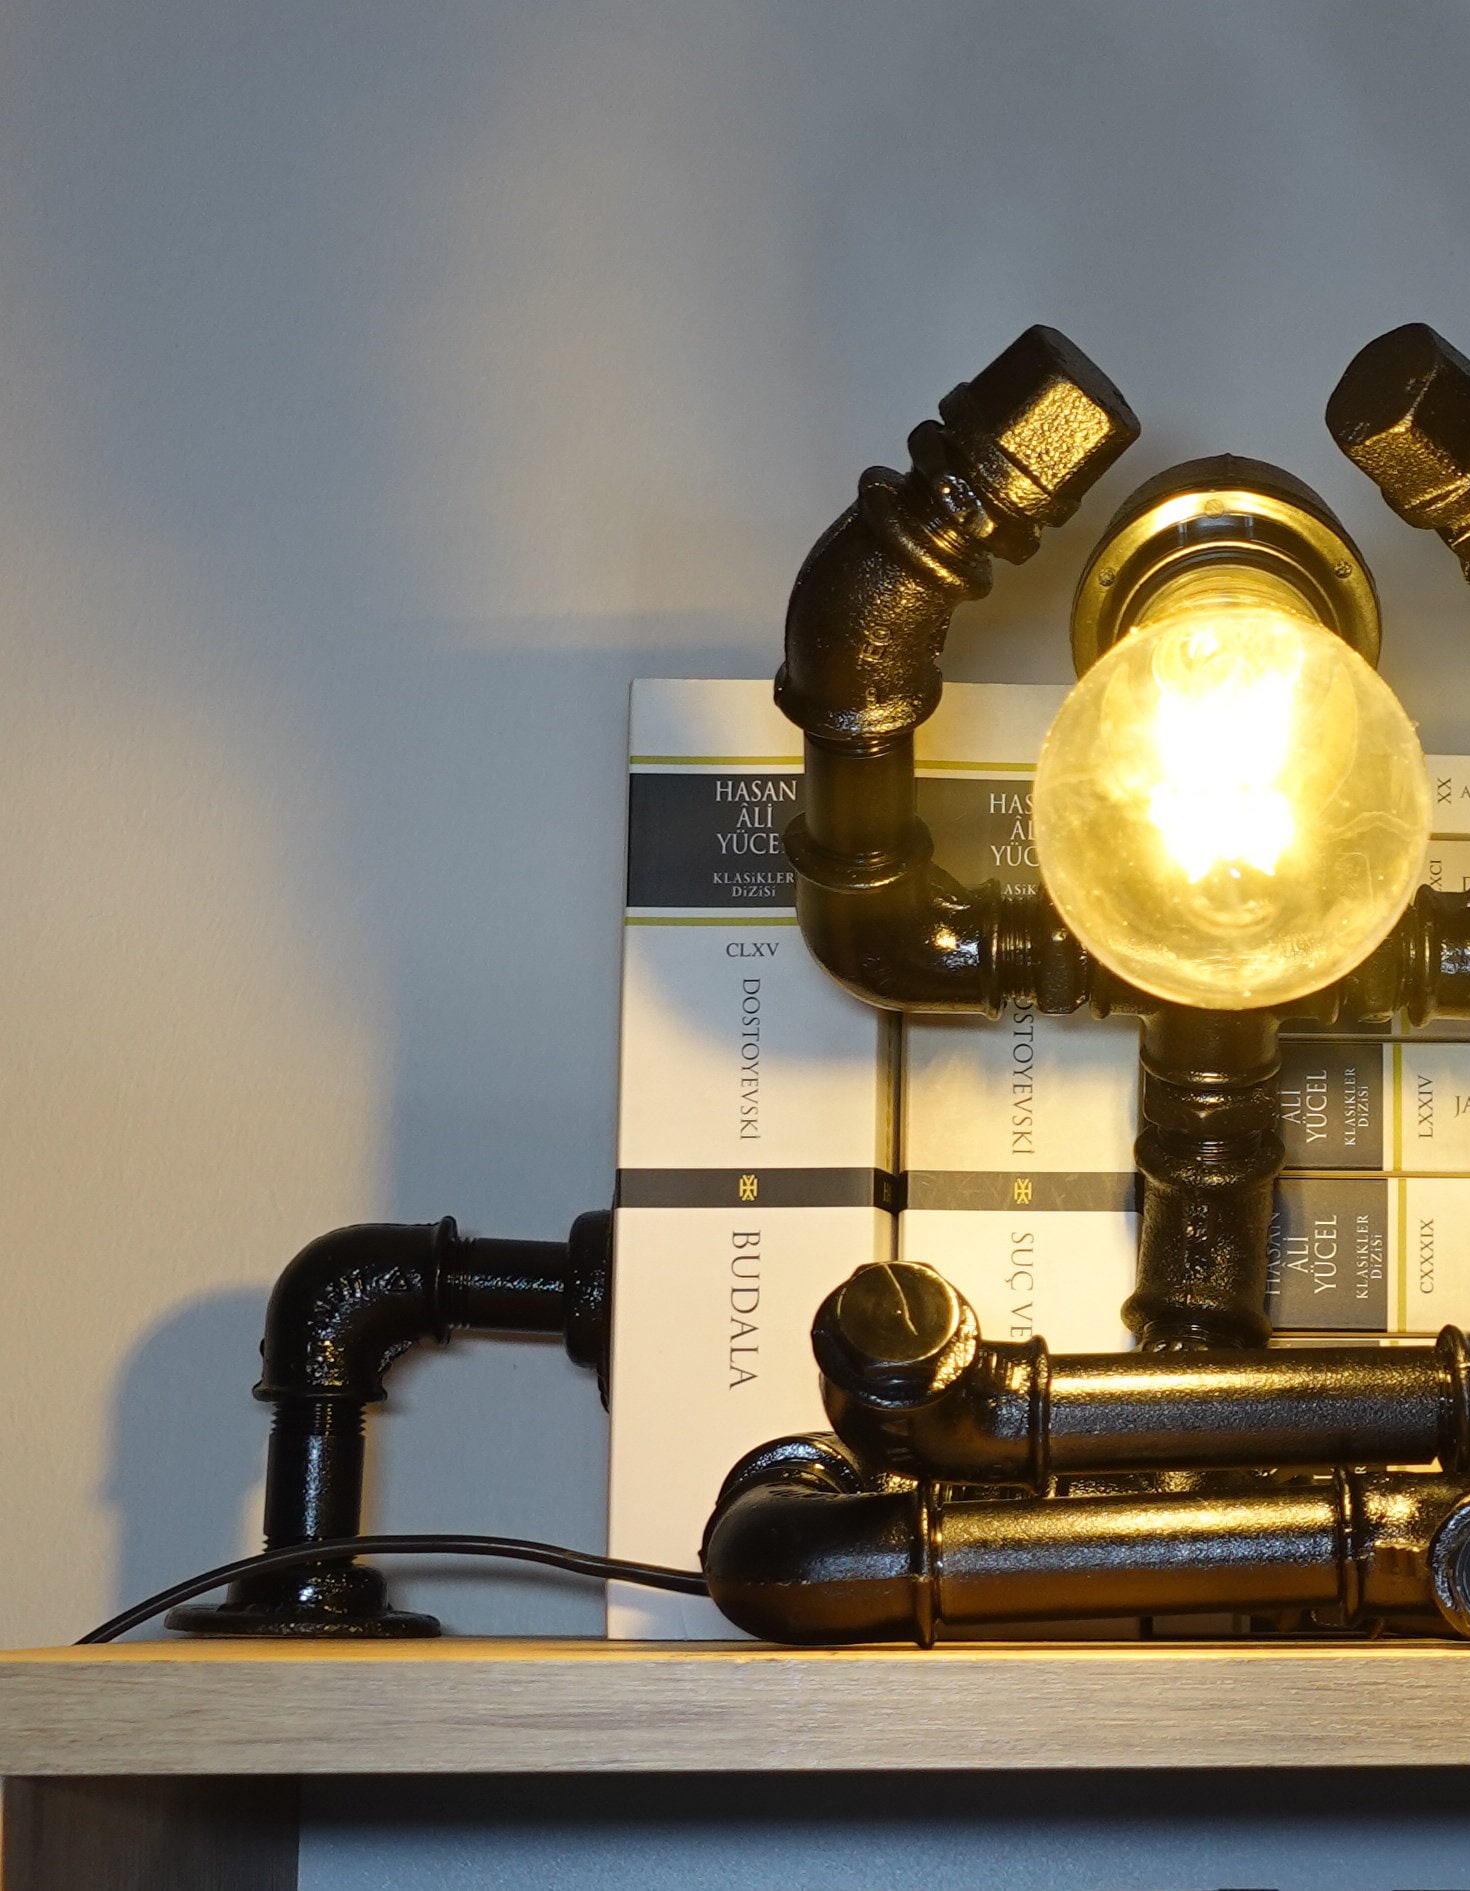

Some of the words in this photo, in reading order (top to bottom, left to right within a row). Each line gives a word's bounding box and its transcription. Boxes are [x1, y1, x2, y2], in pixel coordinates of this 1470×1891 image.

[715, 780, 797, 802] HASAN
[989, 792, 1034, 815] HAS
[1436, 777, 1453, 805] XX
[736, 802, 773, 828] ÂLİ
[1010, 815, 1036, 841] ÂL
[990, 841, 1040, 867] YÜC
[1429, 860, 1443, 891] XCI
[725, 942, 780, 958] CLXV
[1011, 999, 1036, 1154] OSTOYEVSKİ
[1301, 1069, 1328, 1144] YÜCEL
[1418, 1075, 1434, 1139] LXXIV
[1005, 1231, 1035, 1291] SUÇ
[1282, 1236, 1309, 1274] ÂLİ
[1309, 1214, 1338, 1294] YÜCEL
[1419, 1218, 1435, 1294] CXXXIX
[728, 1230, 762, 1390] BUDALA
[1010, 1302, 1034, 1338] VE
